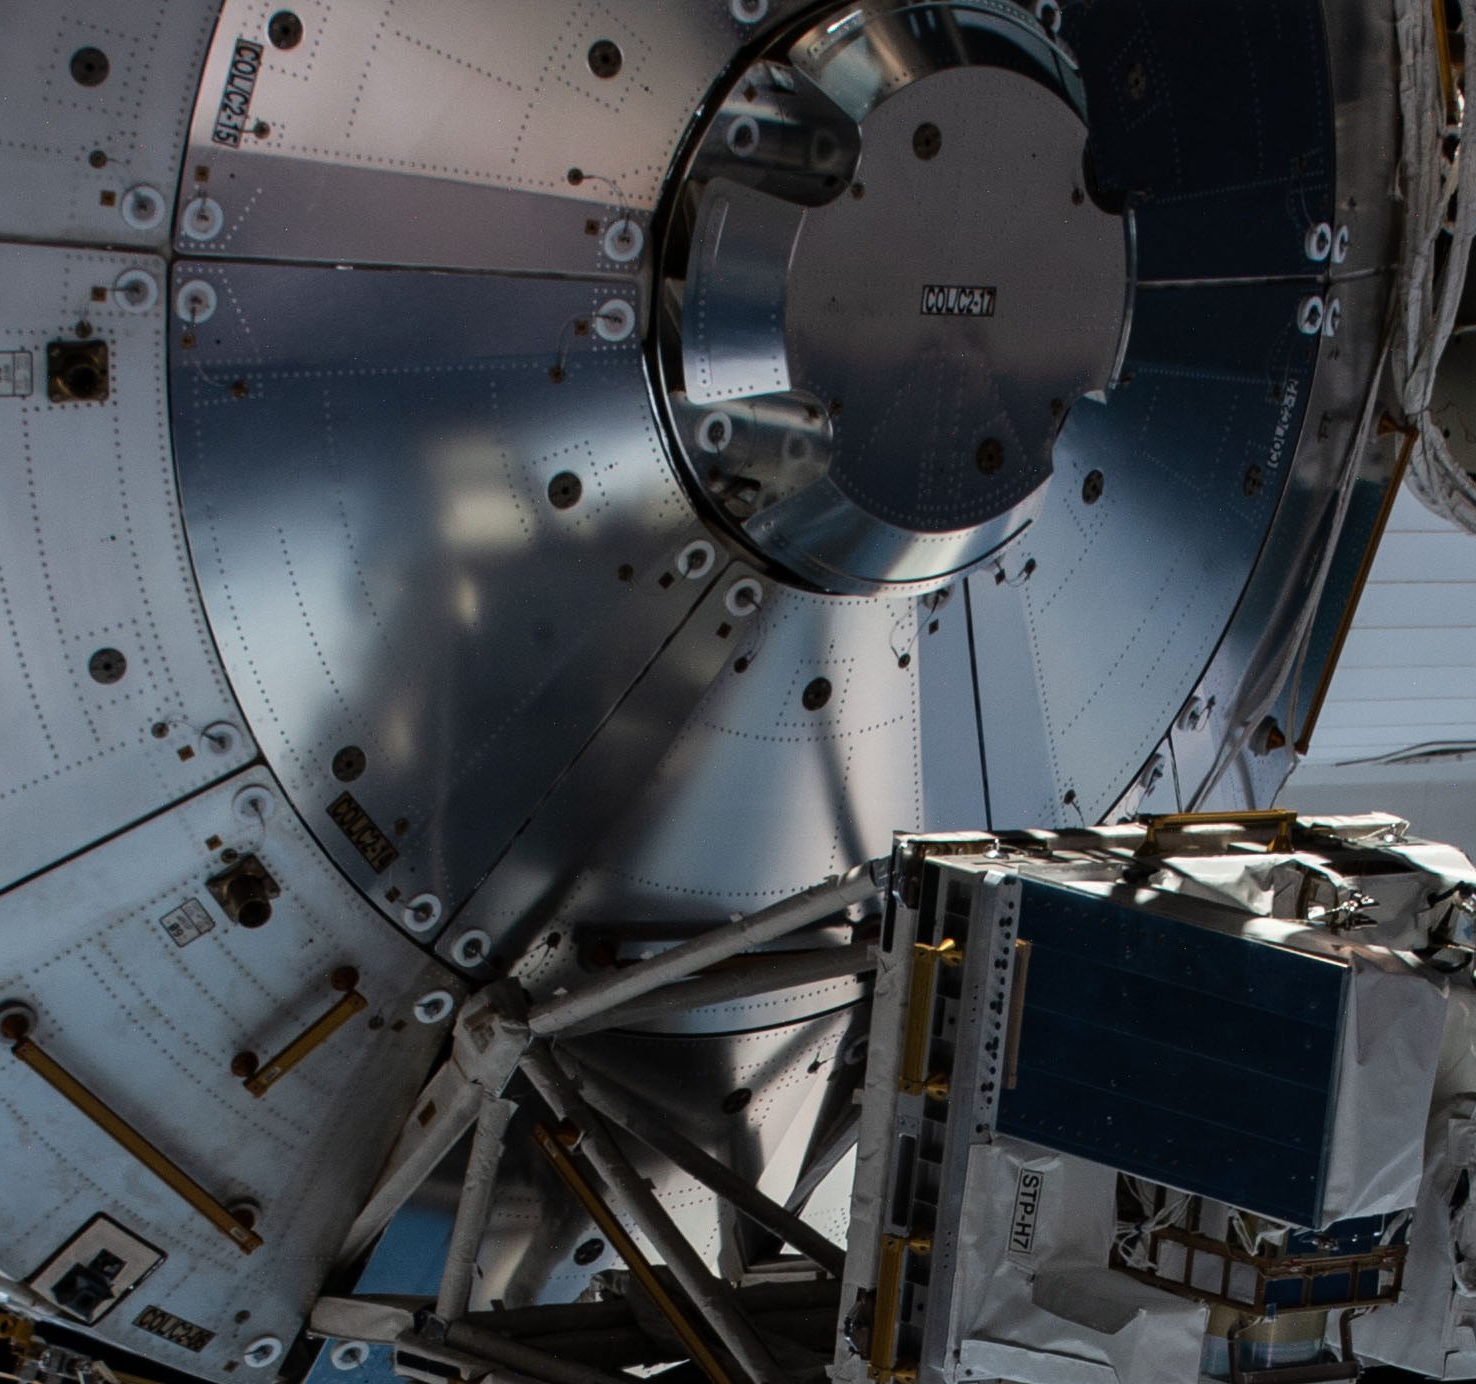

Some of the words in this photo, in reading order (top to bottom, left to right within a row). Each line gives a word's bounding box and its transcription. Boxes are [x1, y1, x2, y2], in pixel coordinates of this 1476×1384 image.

[215, 45, 261, 144] COL/C2-15
[925, 287, 995, 314] COL/C2-17
[1013, 1174, 1040, 1250] STP-H7
